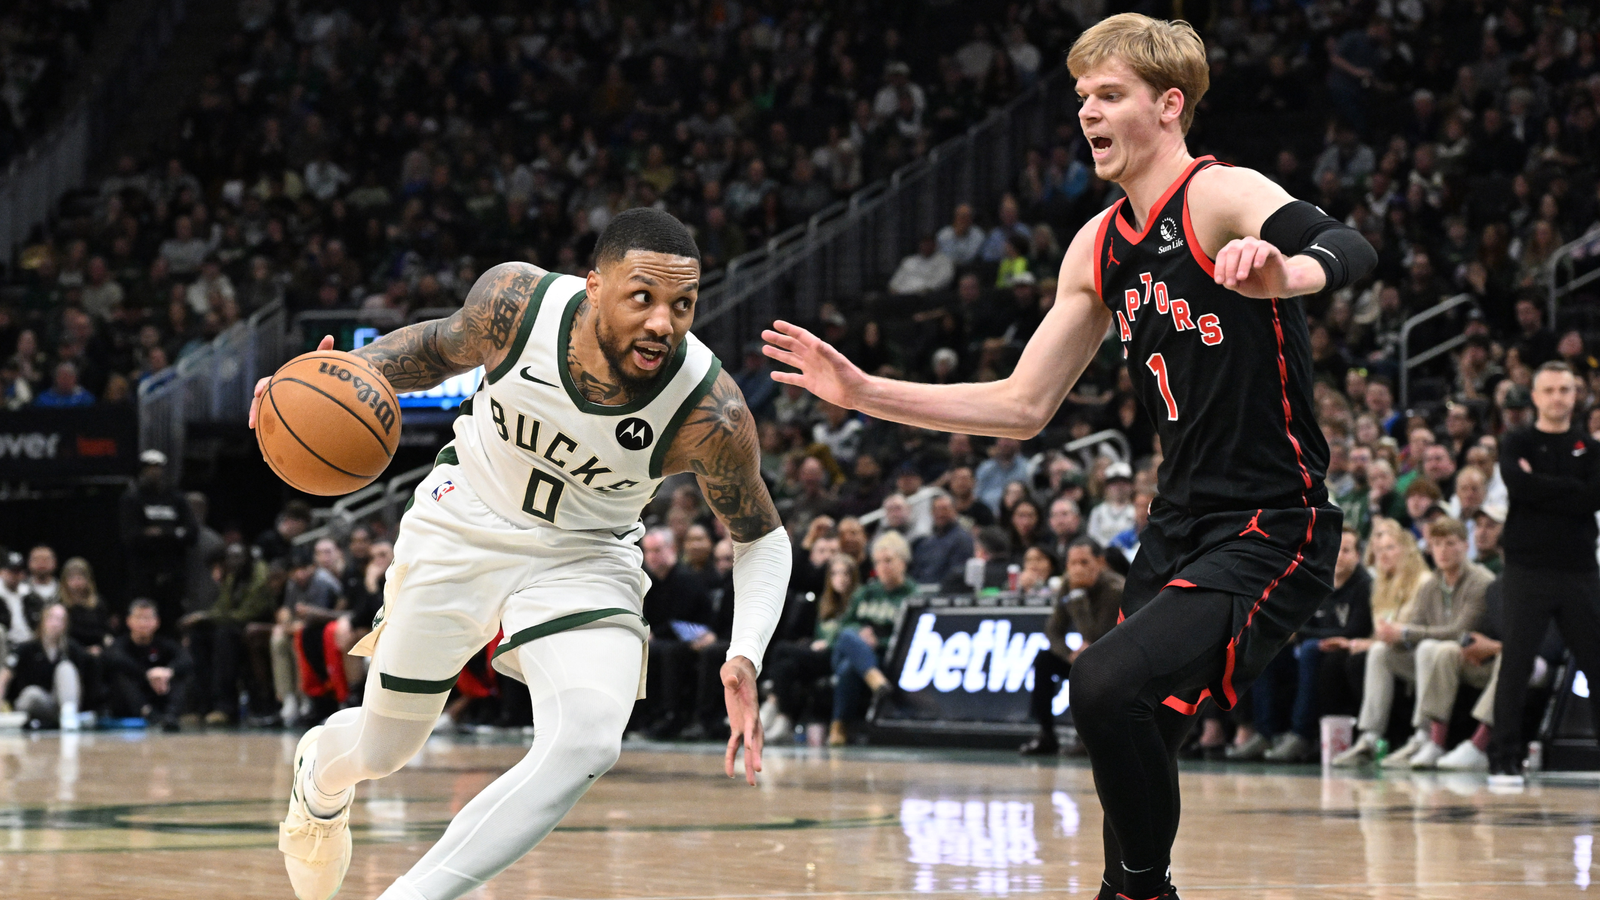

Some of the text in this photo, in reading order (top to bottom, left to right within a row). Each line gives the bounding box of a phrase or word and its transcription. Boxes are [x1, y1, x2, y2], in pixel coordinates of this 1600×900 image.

[1158, 238, 1184, 254] Sun Life
[1116, 272, 1224, 360] APTORS
[318, 361, 396, 436] Wilson
[1146, 353, 1178, 421] 1
[522, 467, 565, 524] 0
